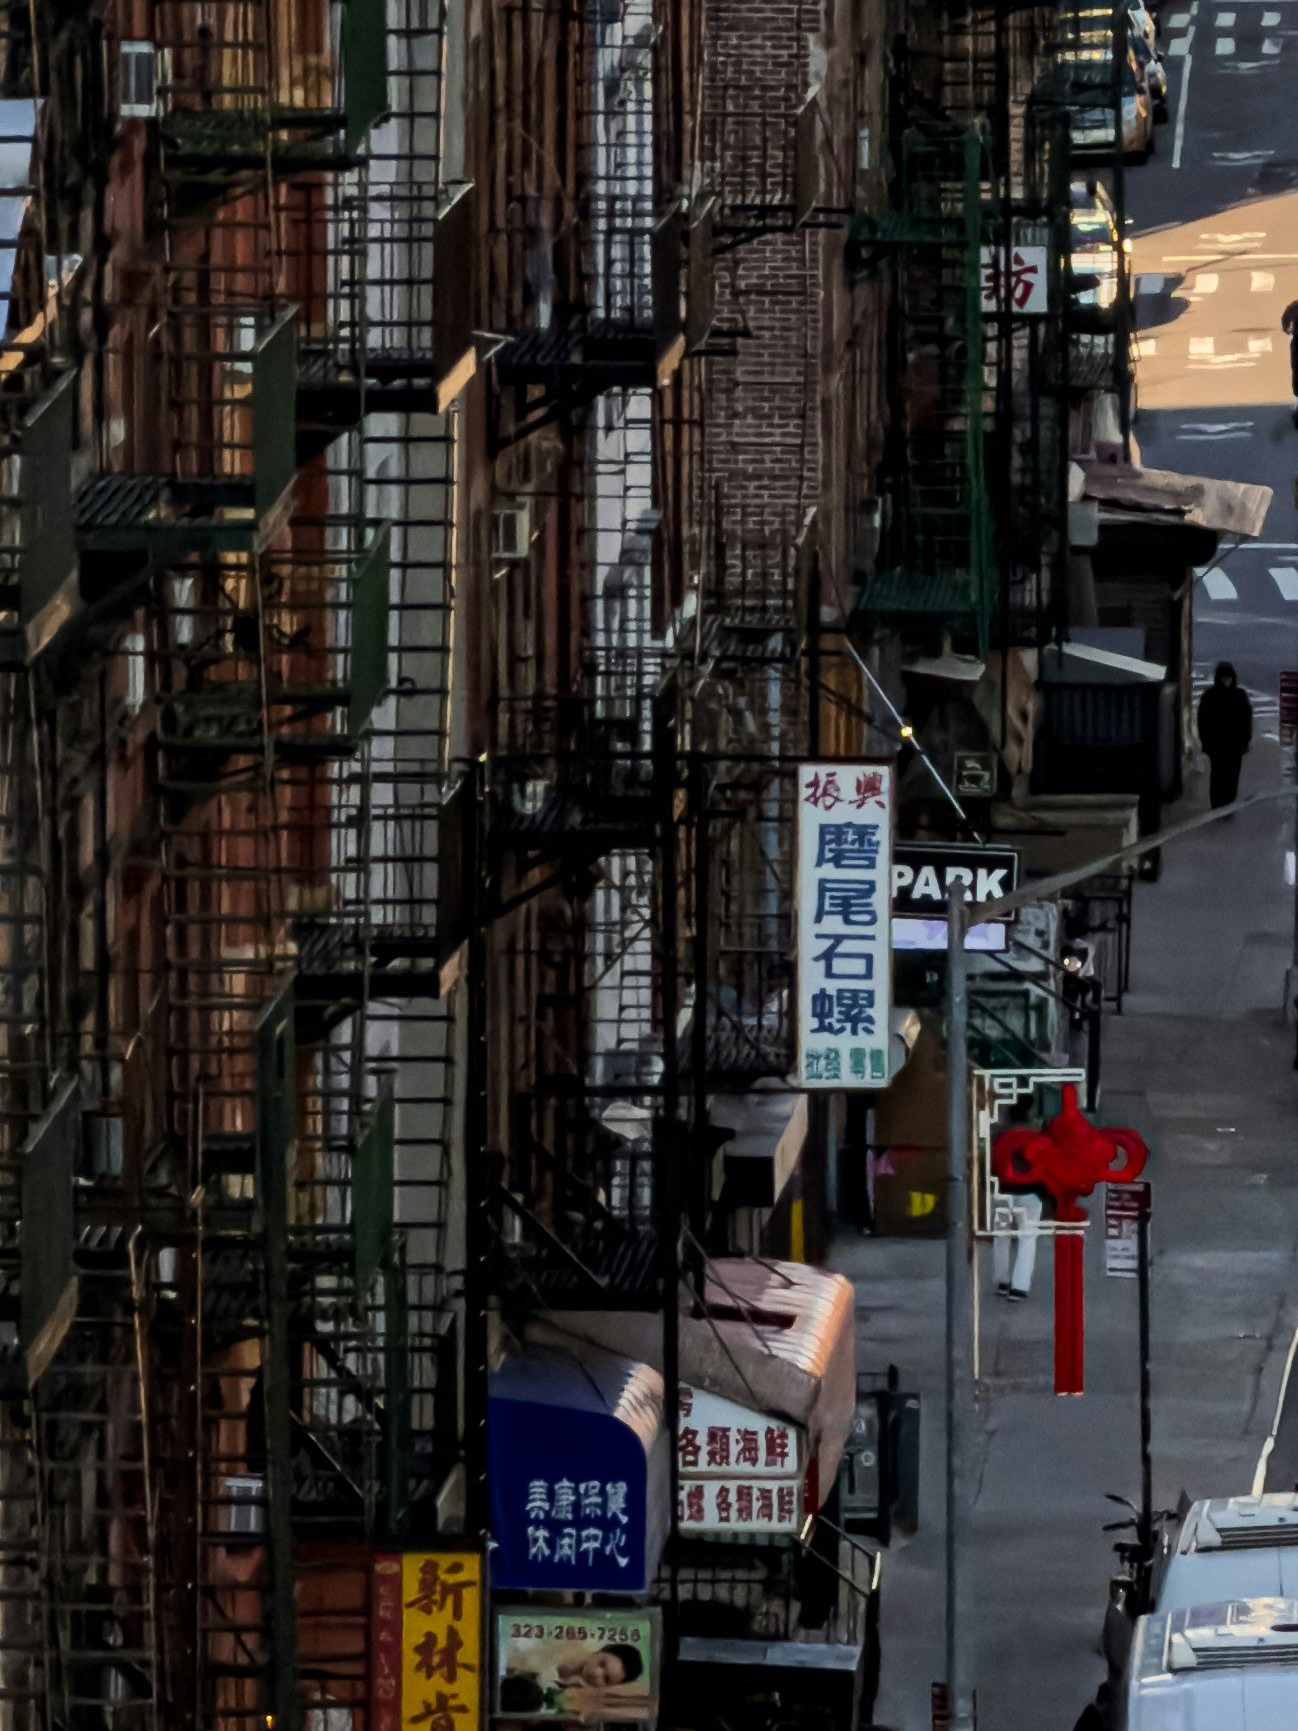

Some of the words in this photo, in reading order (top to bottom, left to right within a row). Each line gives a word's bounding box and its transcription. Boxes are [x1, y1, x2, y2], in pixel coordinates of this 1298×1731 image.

[808, 821, 881, 1037] 磨尾石螺
[891, 864, 1008, 903] PARK
